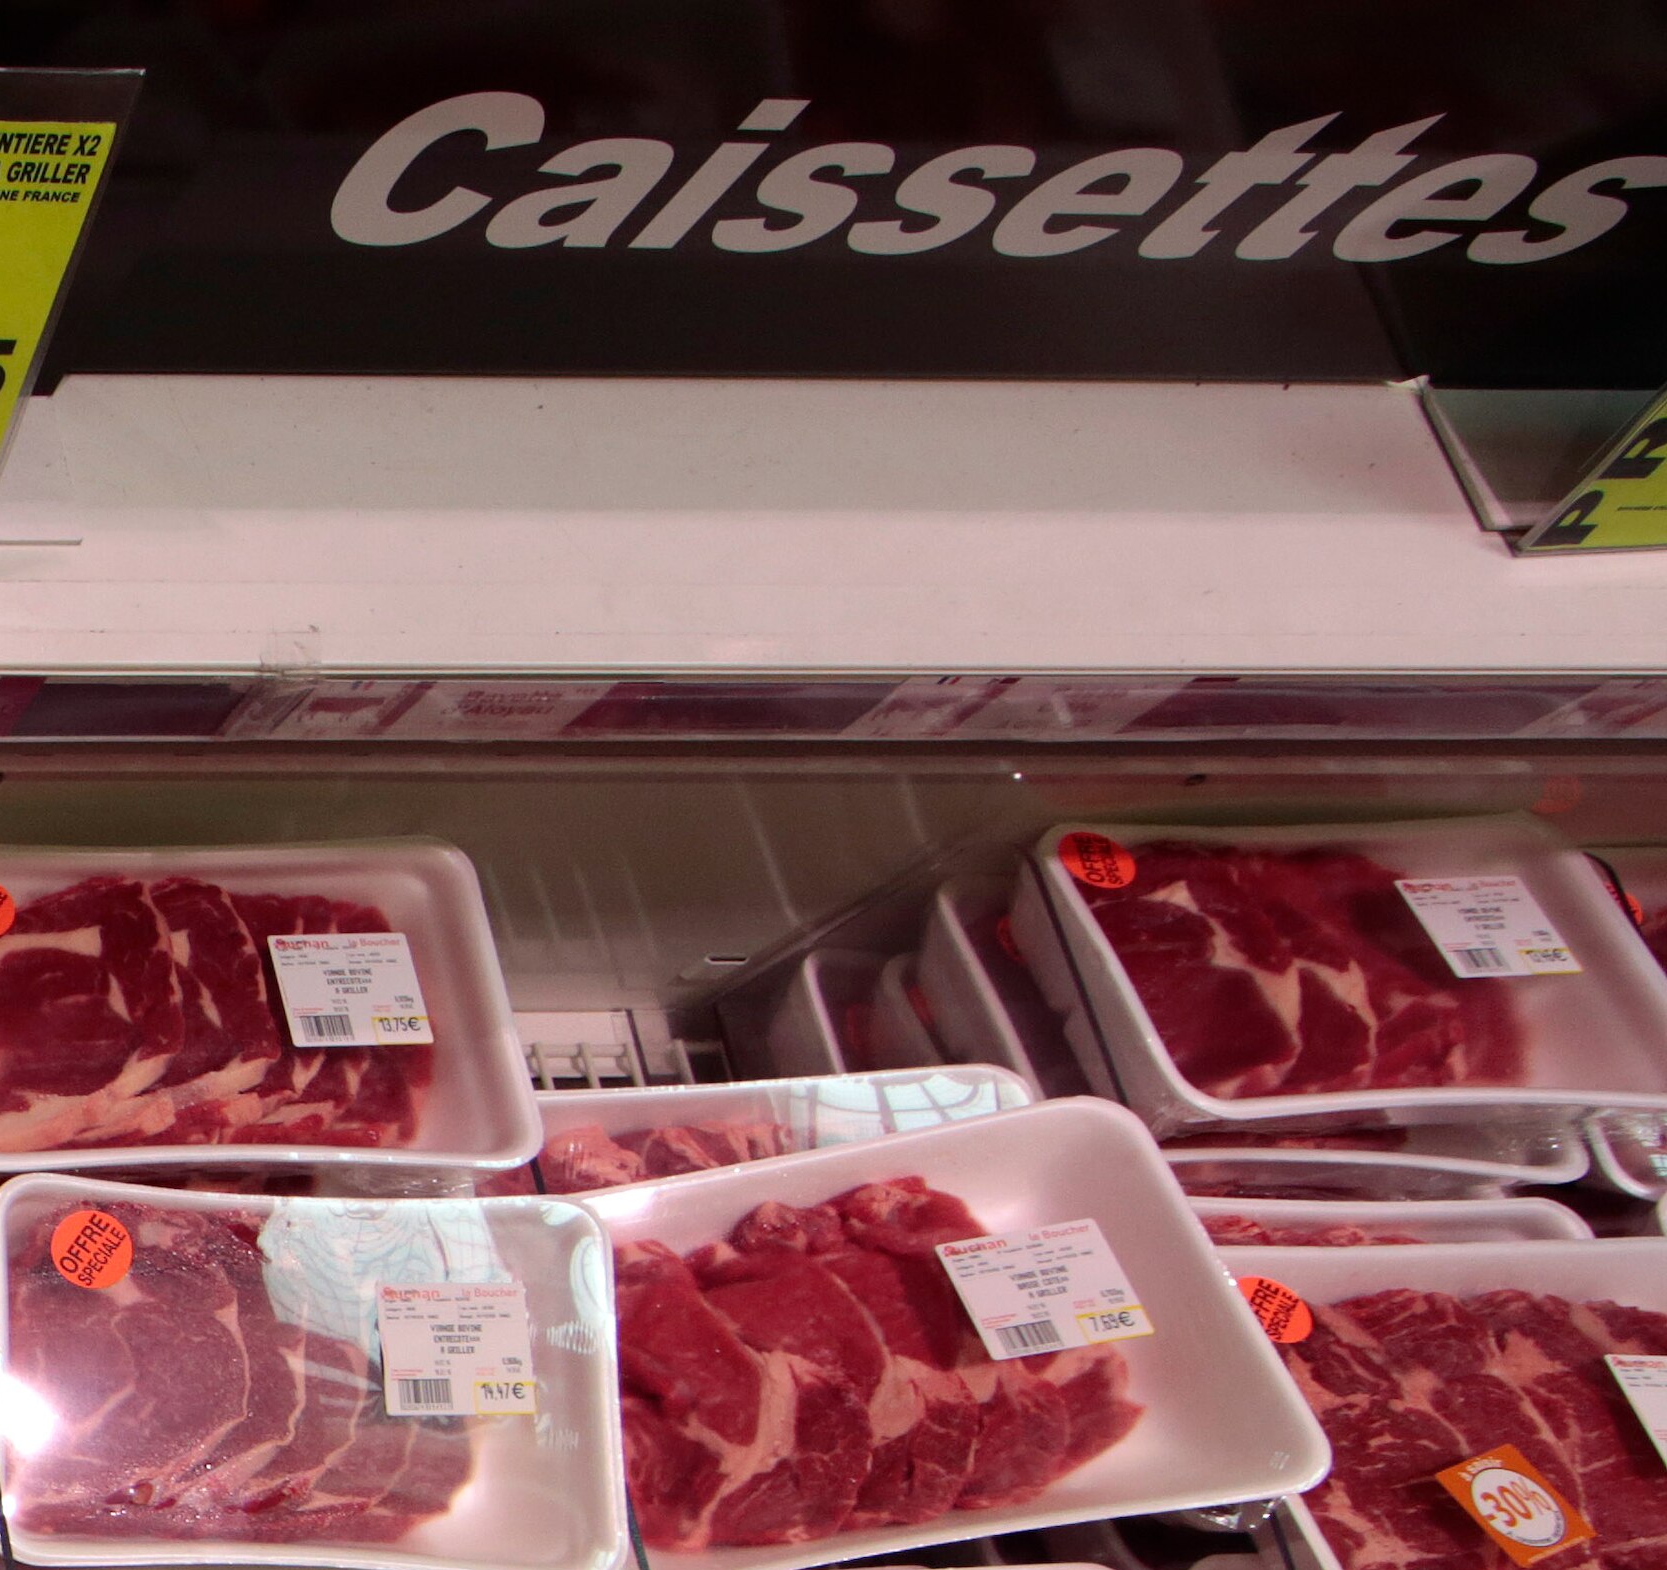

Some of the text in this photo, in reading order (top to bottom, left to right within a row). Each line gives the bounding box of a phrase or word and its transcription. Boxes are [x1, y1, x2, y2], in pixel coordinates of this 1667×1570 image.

[72, 133, 102, 157] X2
[5, 161, 90, 186] GRILLER
[329, 91, 1667, 265] Caissettes
[22, 190, 81, 203] FRANCE
[60, 1213, 112, 1275] OFFRE
[77, 1225, 127, 1287] SPECIALE
